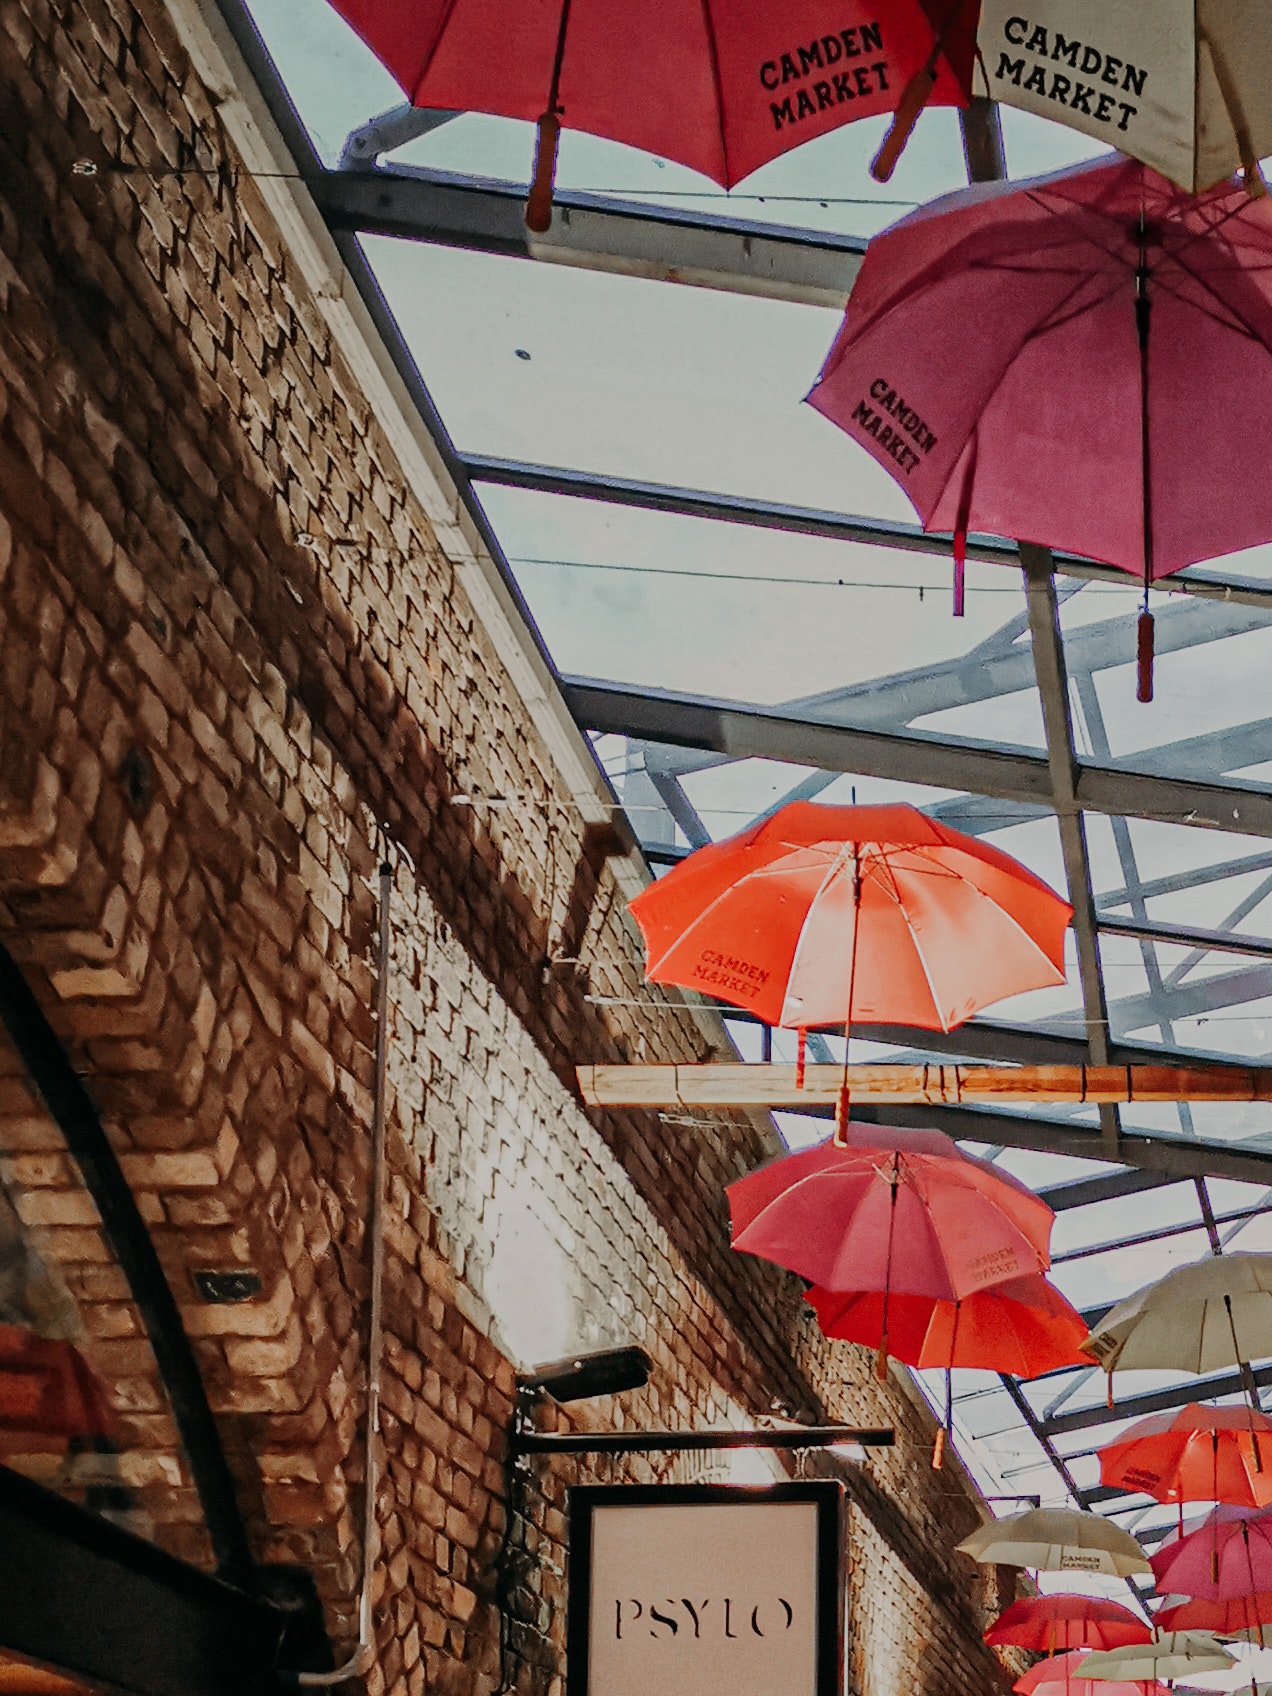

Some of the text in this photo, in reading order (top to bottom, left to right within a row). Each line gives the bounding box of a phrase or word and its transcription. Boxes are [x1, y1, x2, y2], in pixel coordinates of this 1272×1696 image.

[759, 21, 885, 91] CAMDEN
[1003, 16, 1149, 97] CAMDEN
[770, 61, 890, 131] MARKET
[993, 53, 1139, 132] MARKET
[851, 400, 922, 476] MARKET
[869, 376, 938, 455] CAMDEN
[690, 965, 761, 998] MARKET
[700, 948, 771, 983] CAMDEN
[615, 1598, 793, 1640] PSYLO
